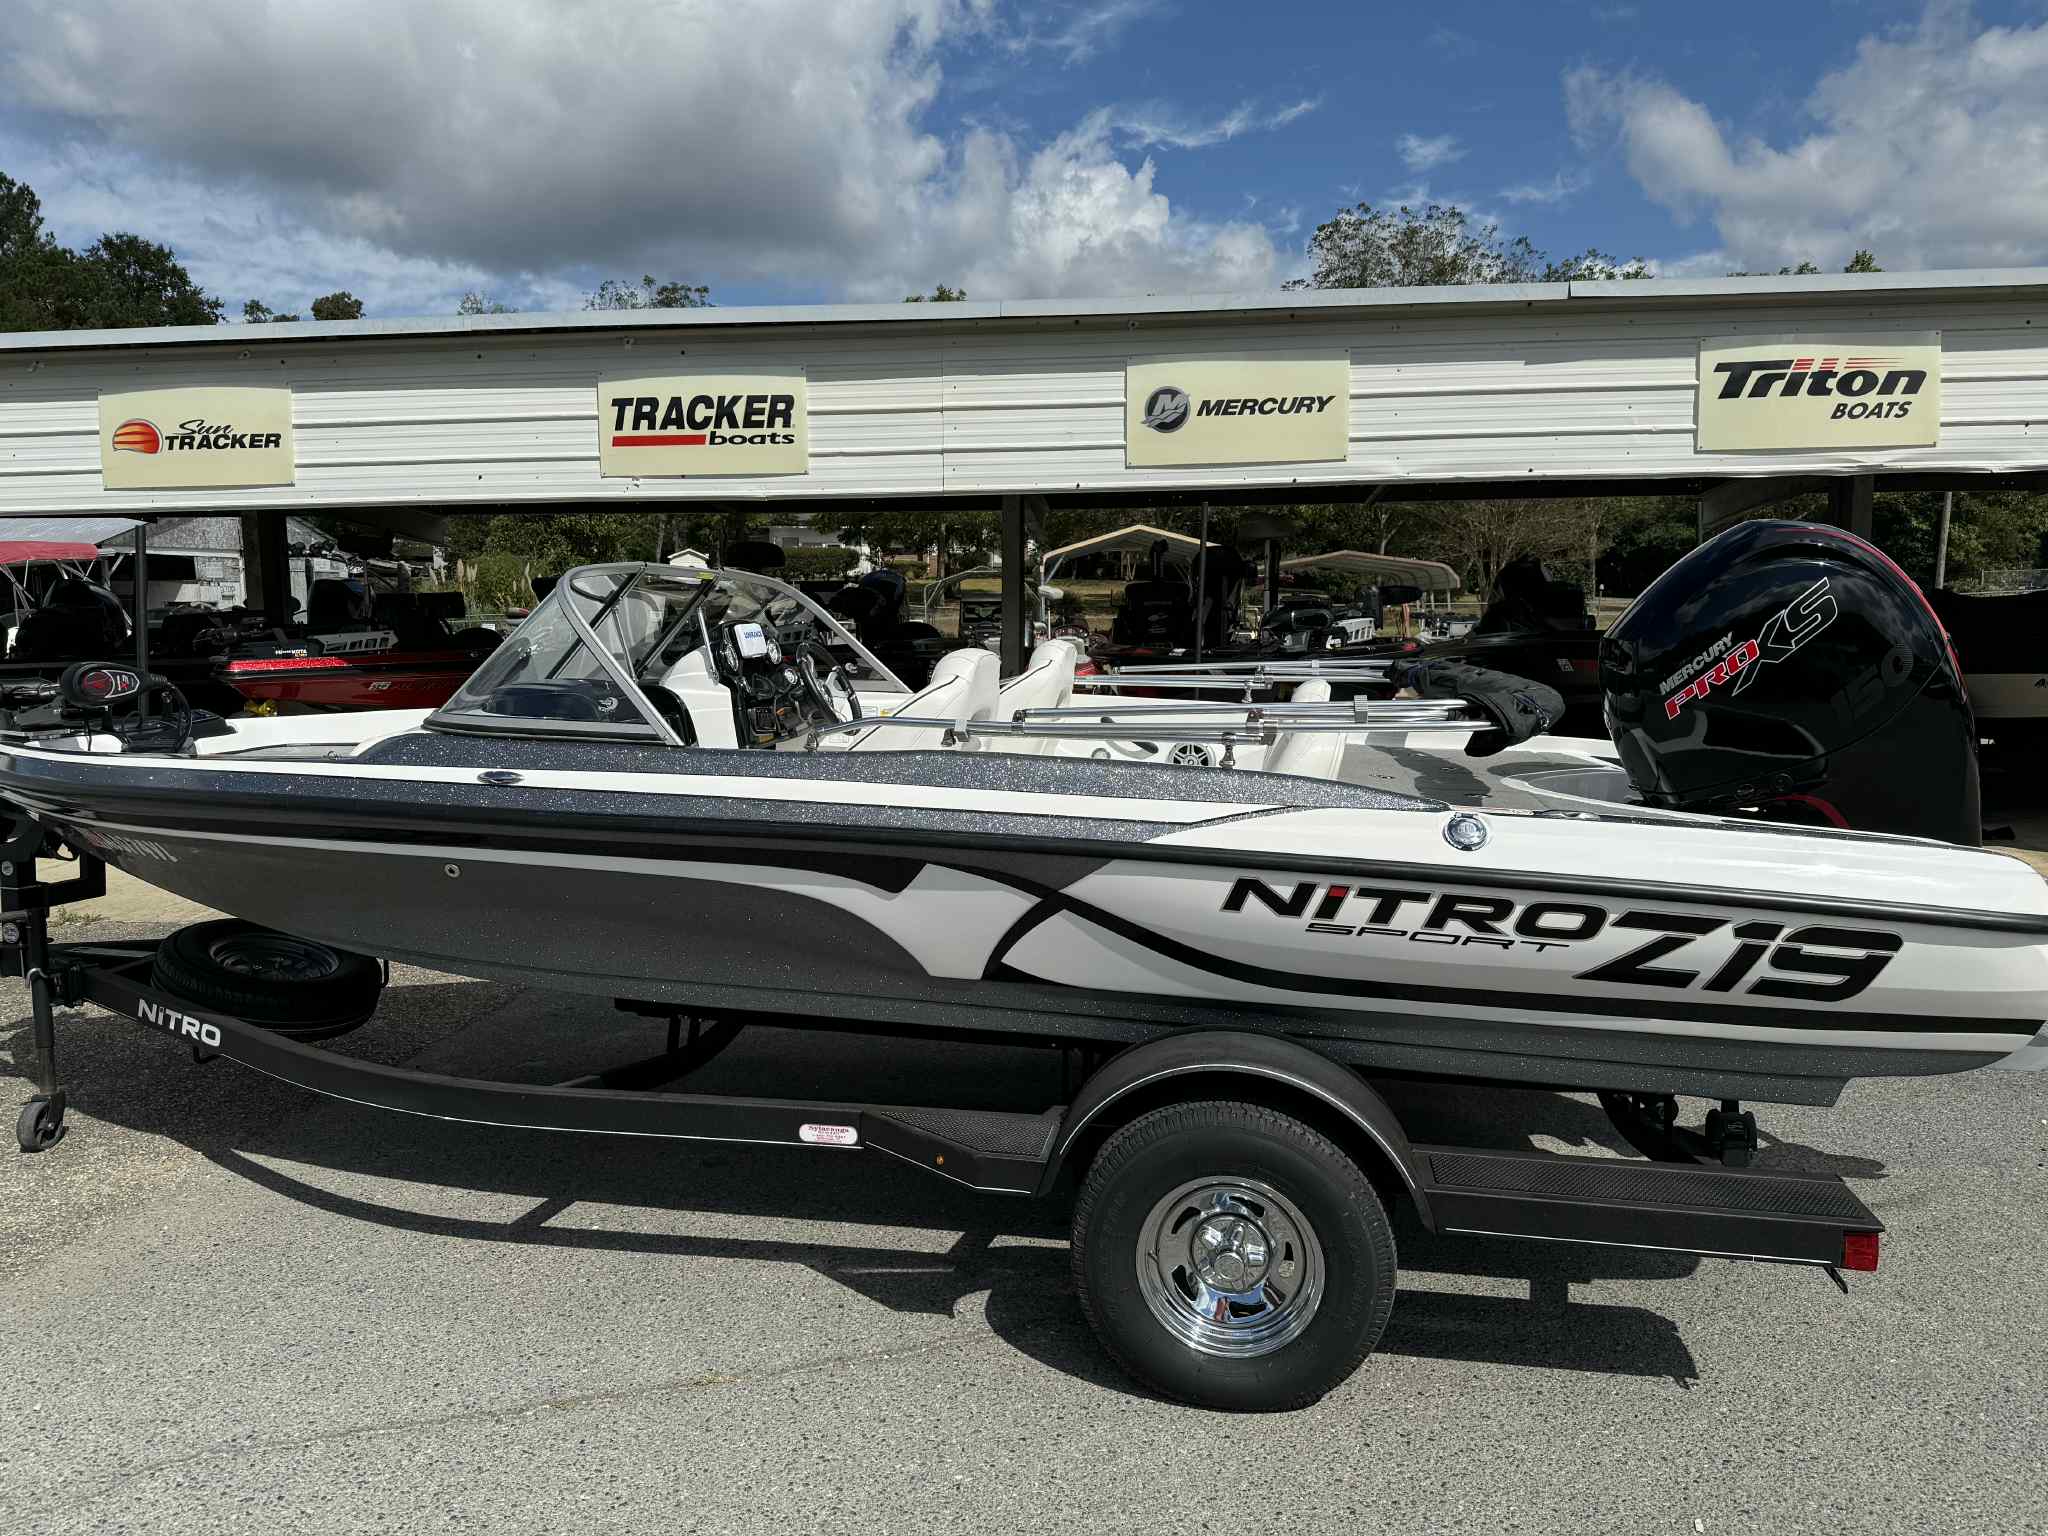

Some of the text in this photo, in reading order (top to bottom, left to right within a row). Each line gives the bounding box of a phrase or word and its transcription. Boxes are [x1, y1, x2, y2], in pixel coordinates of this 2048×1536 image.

[1713, 356, 1928, 400] Triton
[611, 394, 796, 431] TRACKER
[1196, 395, 1337, 417] MERCURY
[1830, 401, 1913, 420] BOATS
[165, 433, 282, 451] TRACKER
[173, 419, 234, 435] Sun
[709, 431, 796, 446] boats
[1659, 631, 1734, 696] MERCURY
[1664, 639, 1761, 720] PRO
[1306, 922, 1571, 953] SPORT
[1572, 907, 1904, 1003] Z19
